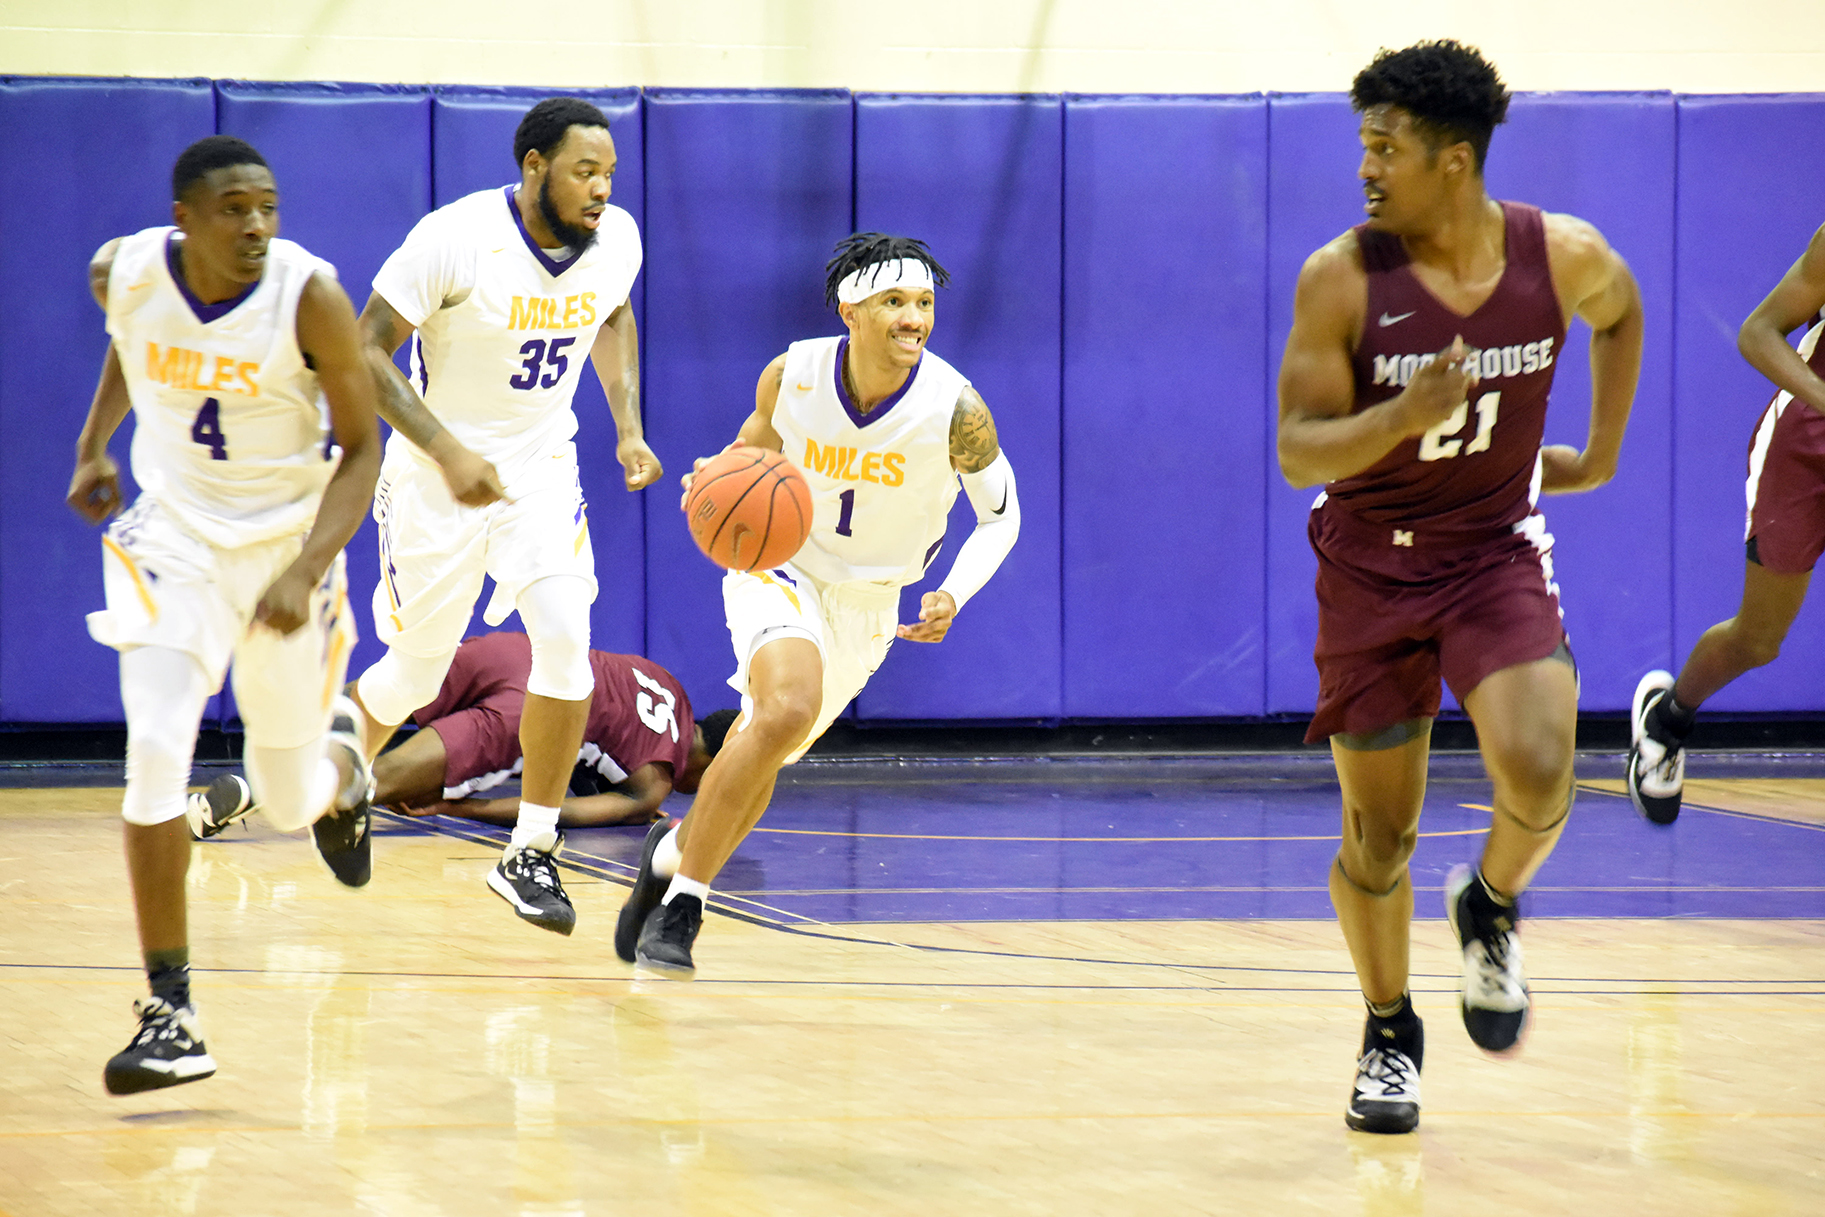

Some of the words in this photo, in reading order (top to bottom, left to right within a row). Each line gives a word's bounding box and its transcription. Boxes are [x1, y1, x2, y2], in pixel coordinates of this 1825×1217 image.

[507, 292, 597, 330] MILES
[146, 341, 260, 397] MILES
[509, 336, 577, 390] 35
[1372, 337, 1554, 387] MOHOUSE
[191, 397, 229, 461] 4
[1418, 391, 1502, 461] 21
[803, 437, 906, 488] MILES
[835, 488, 855, 537] 1
[631, 667, 680, 744] 15
